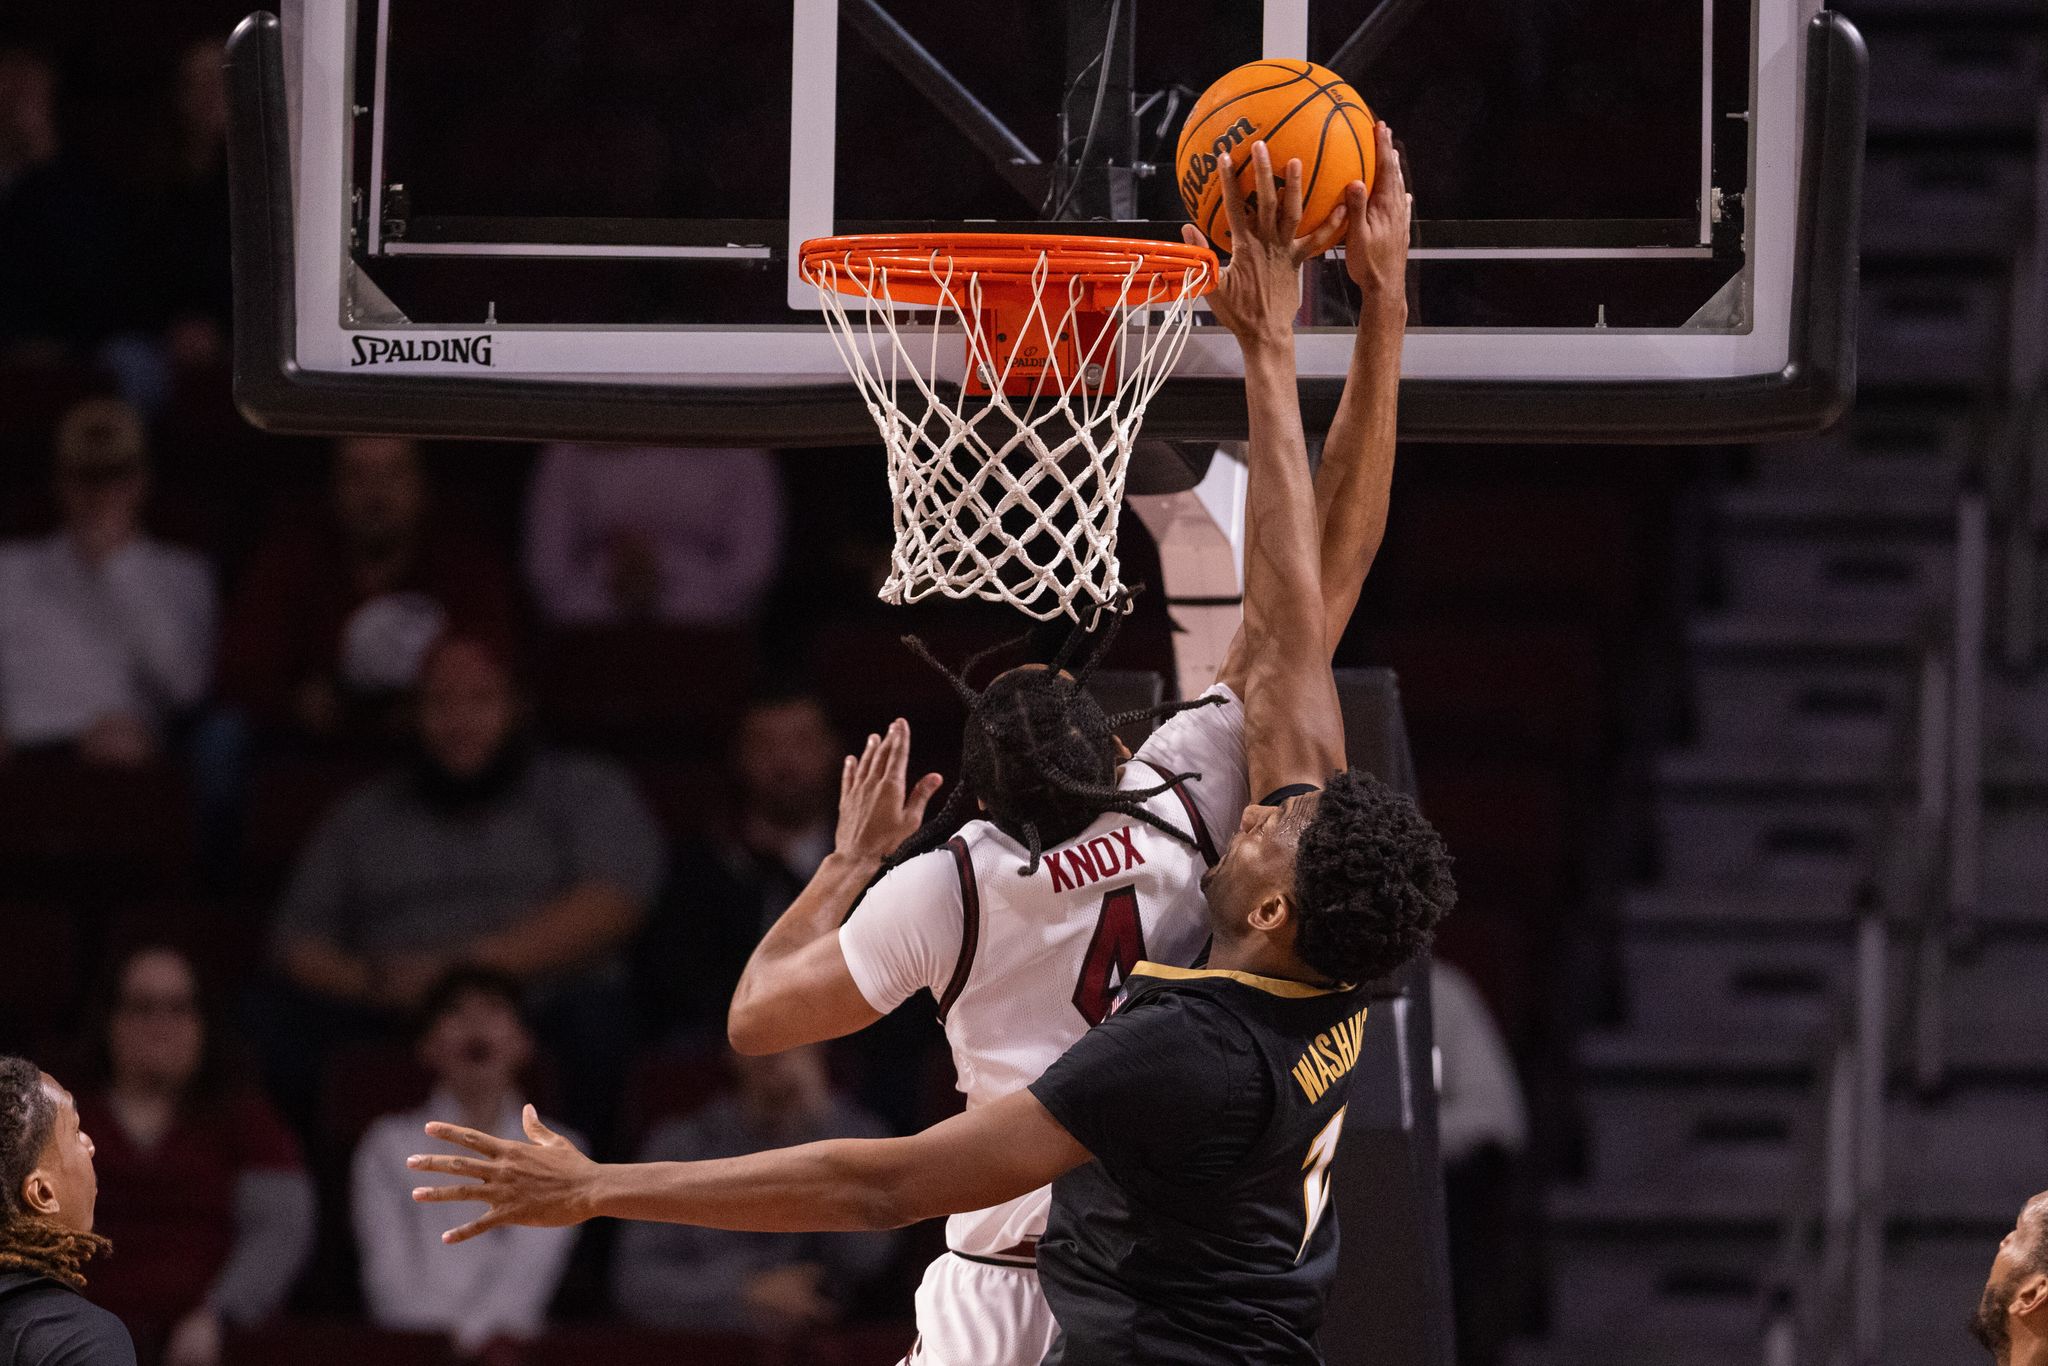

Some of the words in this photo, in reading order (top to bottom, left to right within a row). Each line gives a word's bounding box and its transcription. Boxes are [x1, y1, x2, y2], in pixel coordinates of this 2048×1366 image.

[1182, 117, 1258, 219] Wilson
[351, 335, 492, 366] SPALDING
[1004, 355, 1059, 369] SPALDIN
[1043, 826, 1146, 893] KNOX
[1071, 883, 1148, 1028] 4
